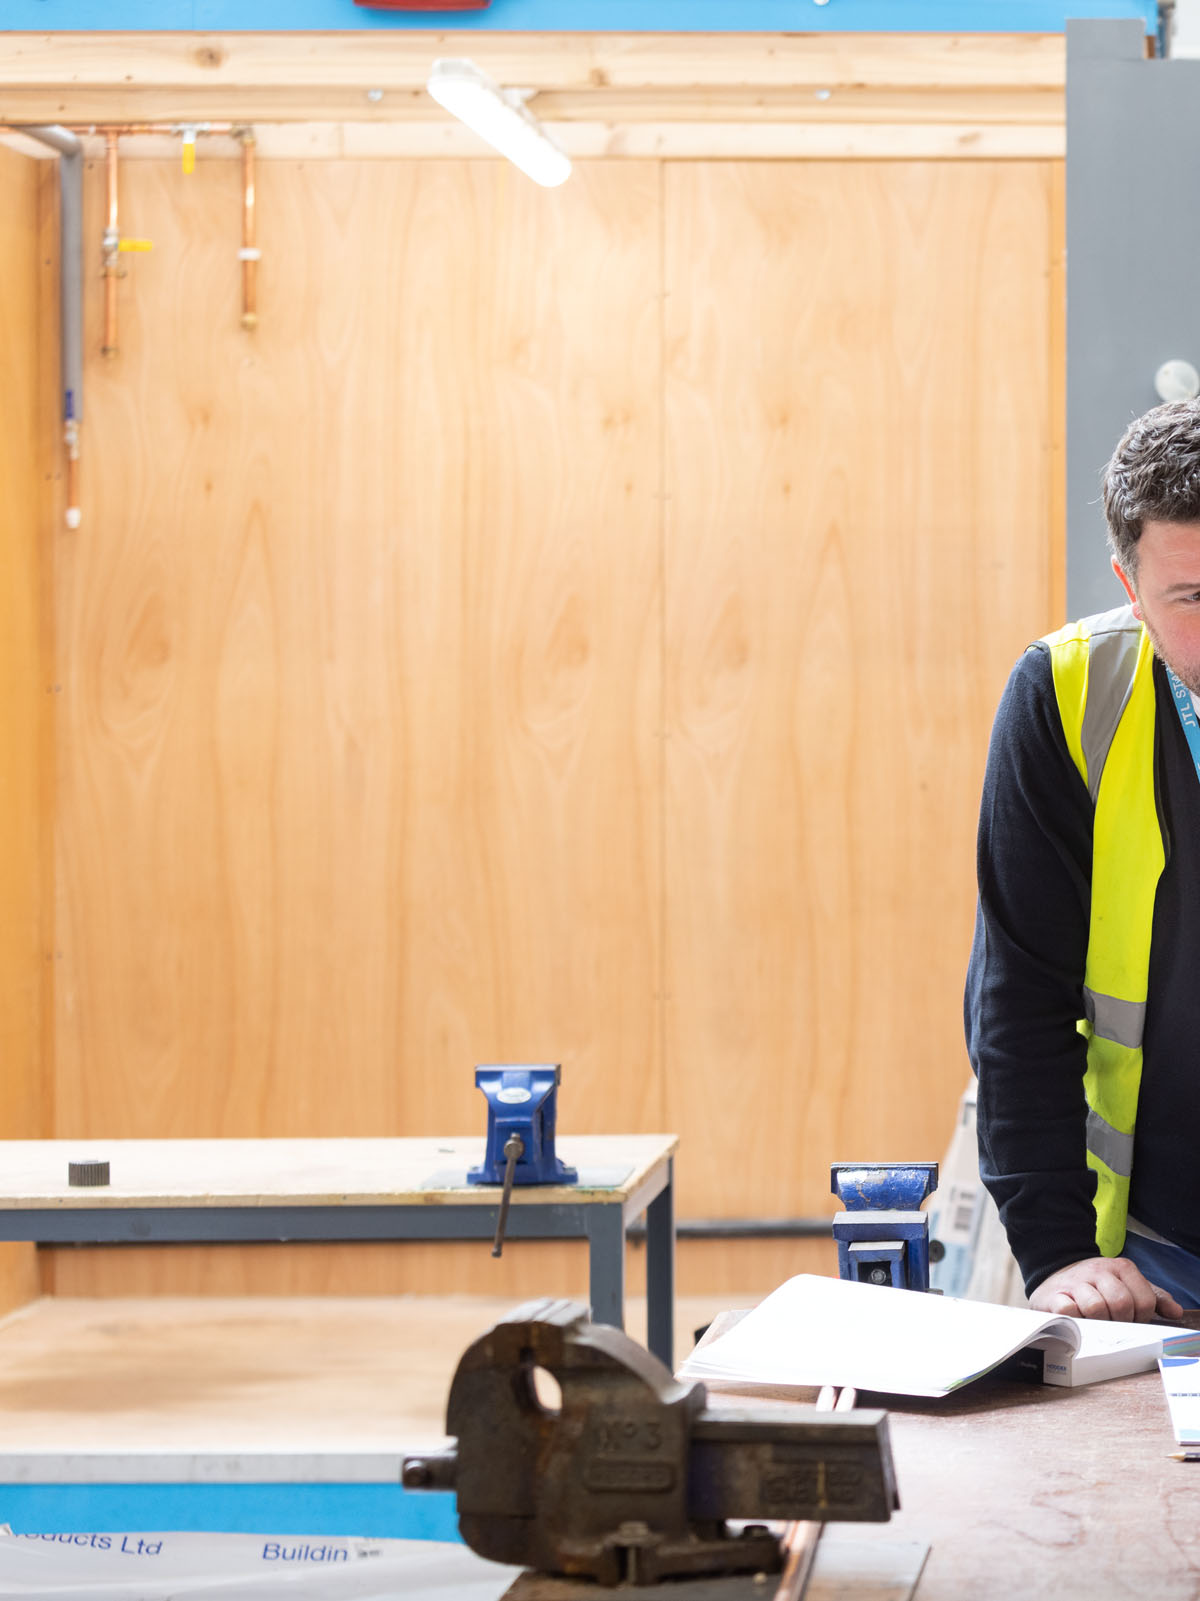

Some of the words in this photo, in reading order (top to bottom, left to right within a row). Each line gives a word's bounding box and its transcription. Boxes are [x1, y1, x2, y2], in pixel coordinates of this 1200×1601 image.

[1171, 674, 1187, 699] STA
[1180, 702, 1197, 727] JTL
[121, 1535, 163, 1555] Ltd
[262, 1542, 348, 1562] Buildin
